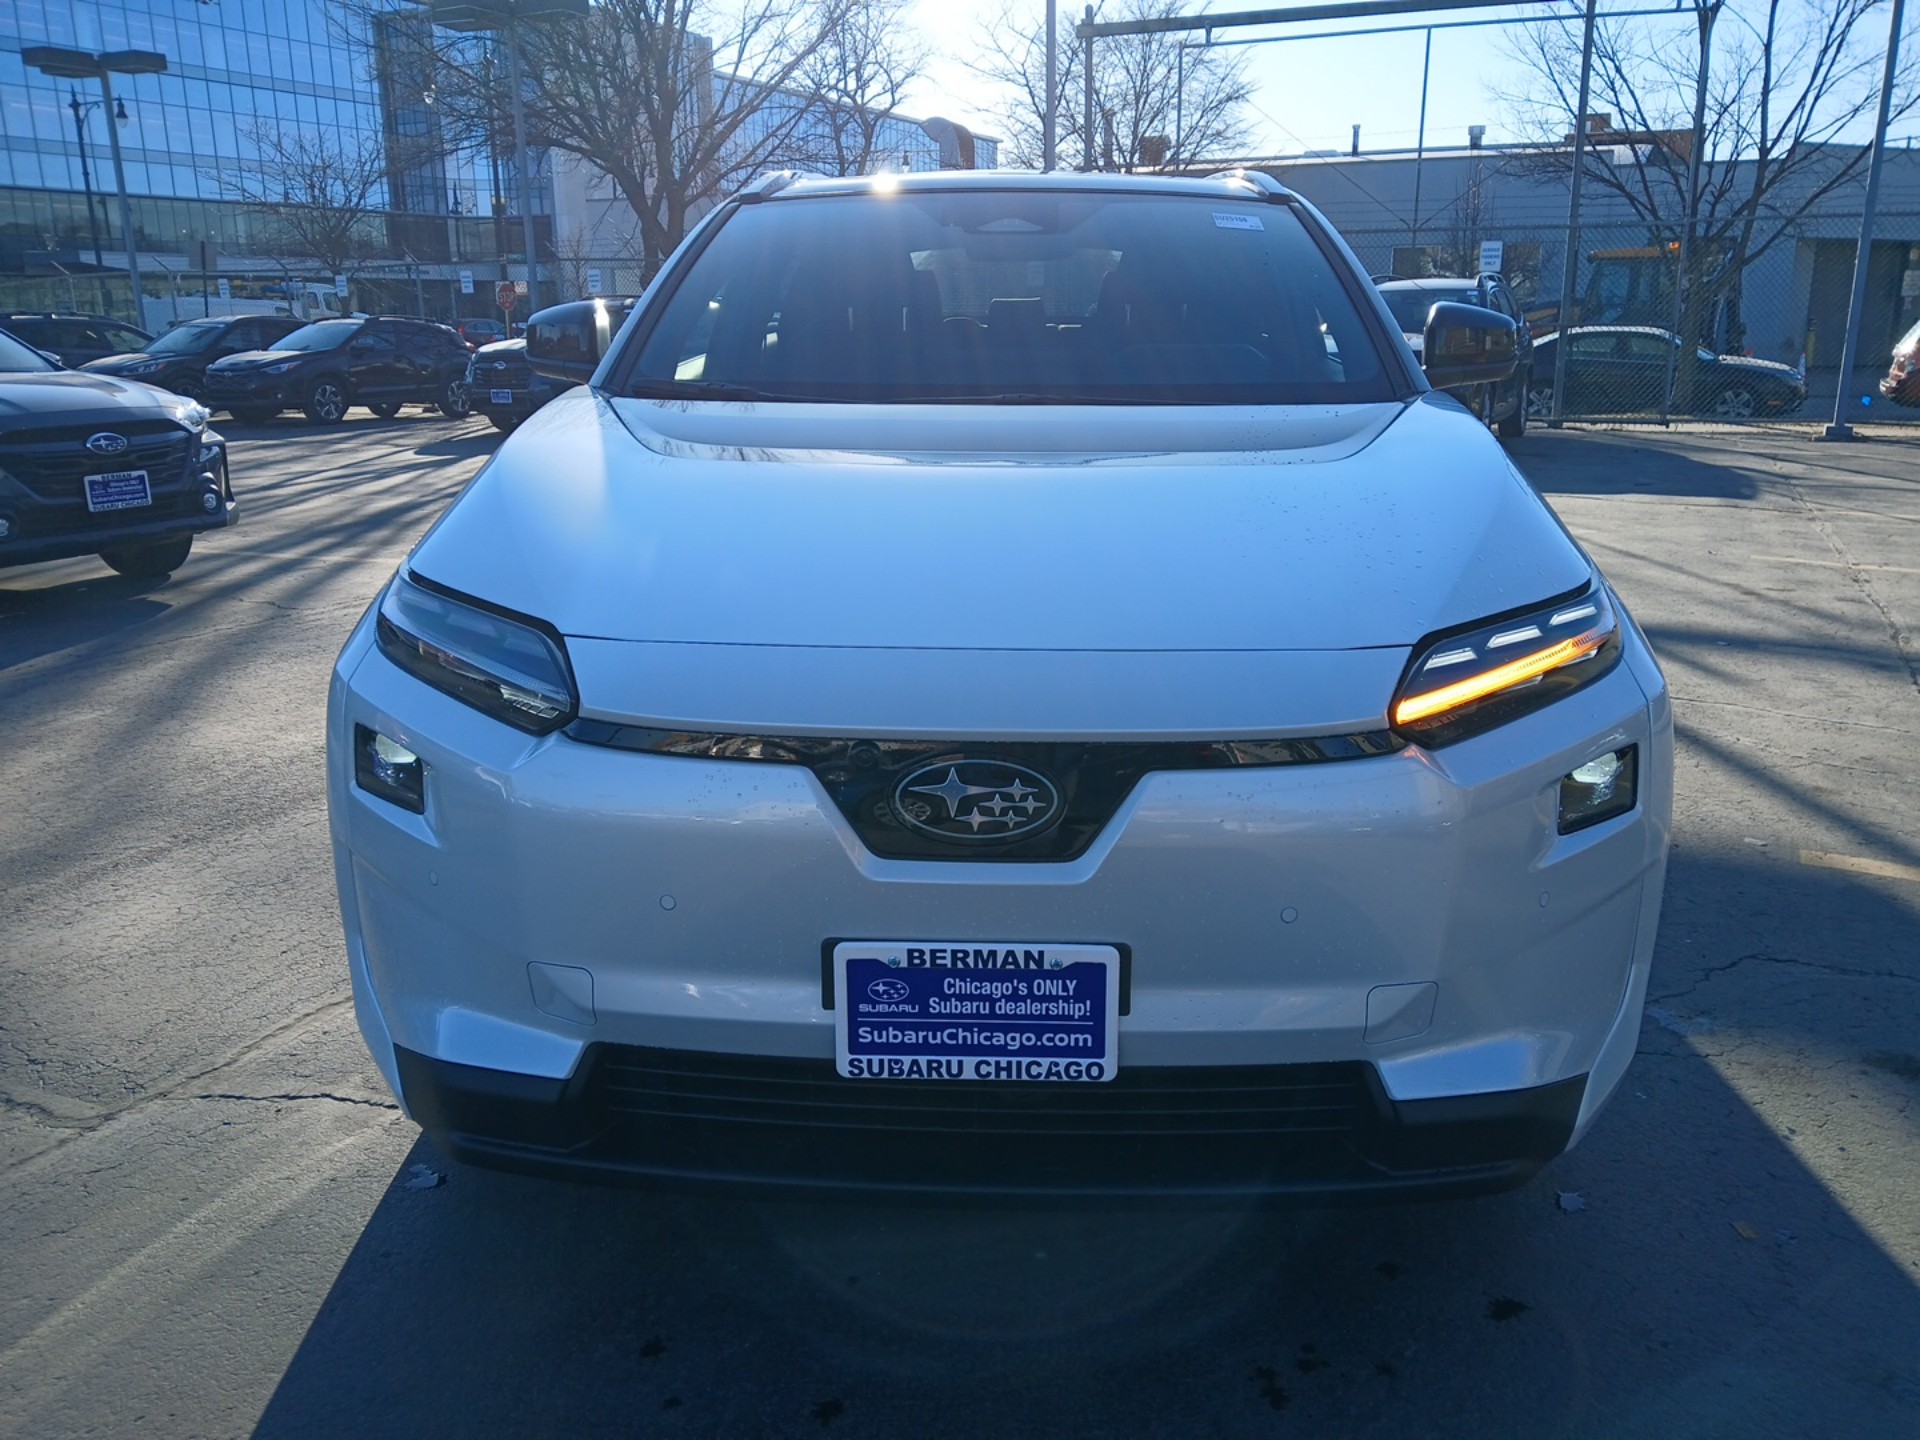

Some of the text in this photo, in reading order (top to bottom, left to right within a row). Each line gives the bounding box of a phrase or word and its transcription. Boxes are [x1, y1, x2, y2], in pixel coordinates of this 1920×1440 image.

[499, 291, 516, 302] STOP
[101, 472, 133, 480] BERMAN
[906, 948, 1045, 969] BERMAN
[943, 978, 1077, 998] Chicago's ONLY
[859, 1003, 919, 1013] SUBARU
[929, 997, 1091, 1019] Subaru dealership!
[858, 1027, 1092, 1049] SubaruChicago.com
[848, 1058, 1105, 1081] SUBARU CHICAGO
